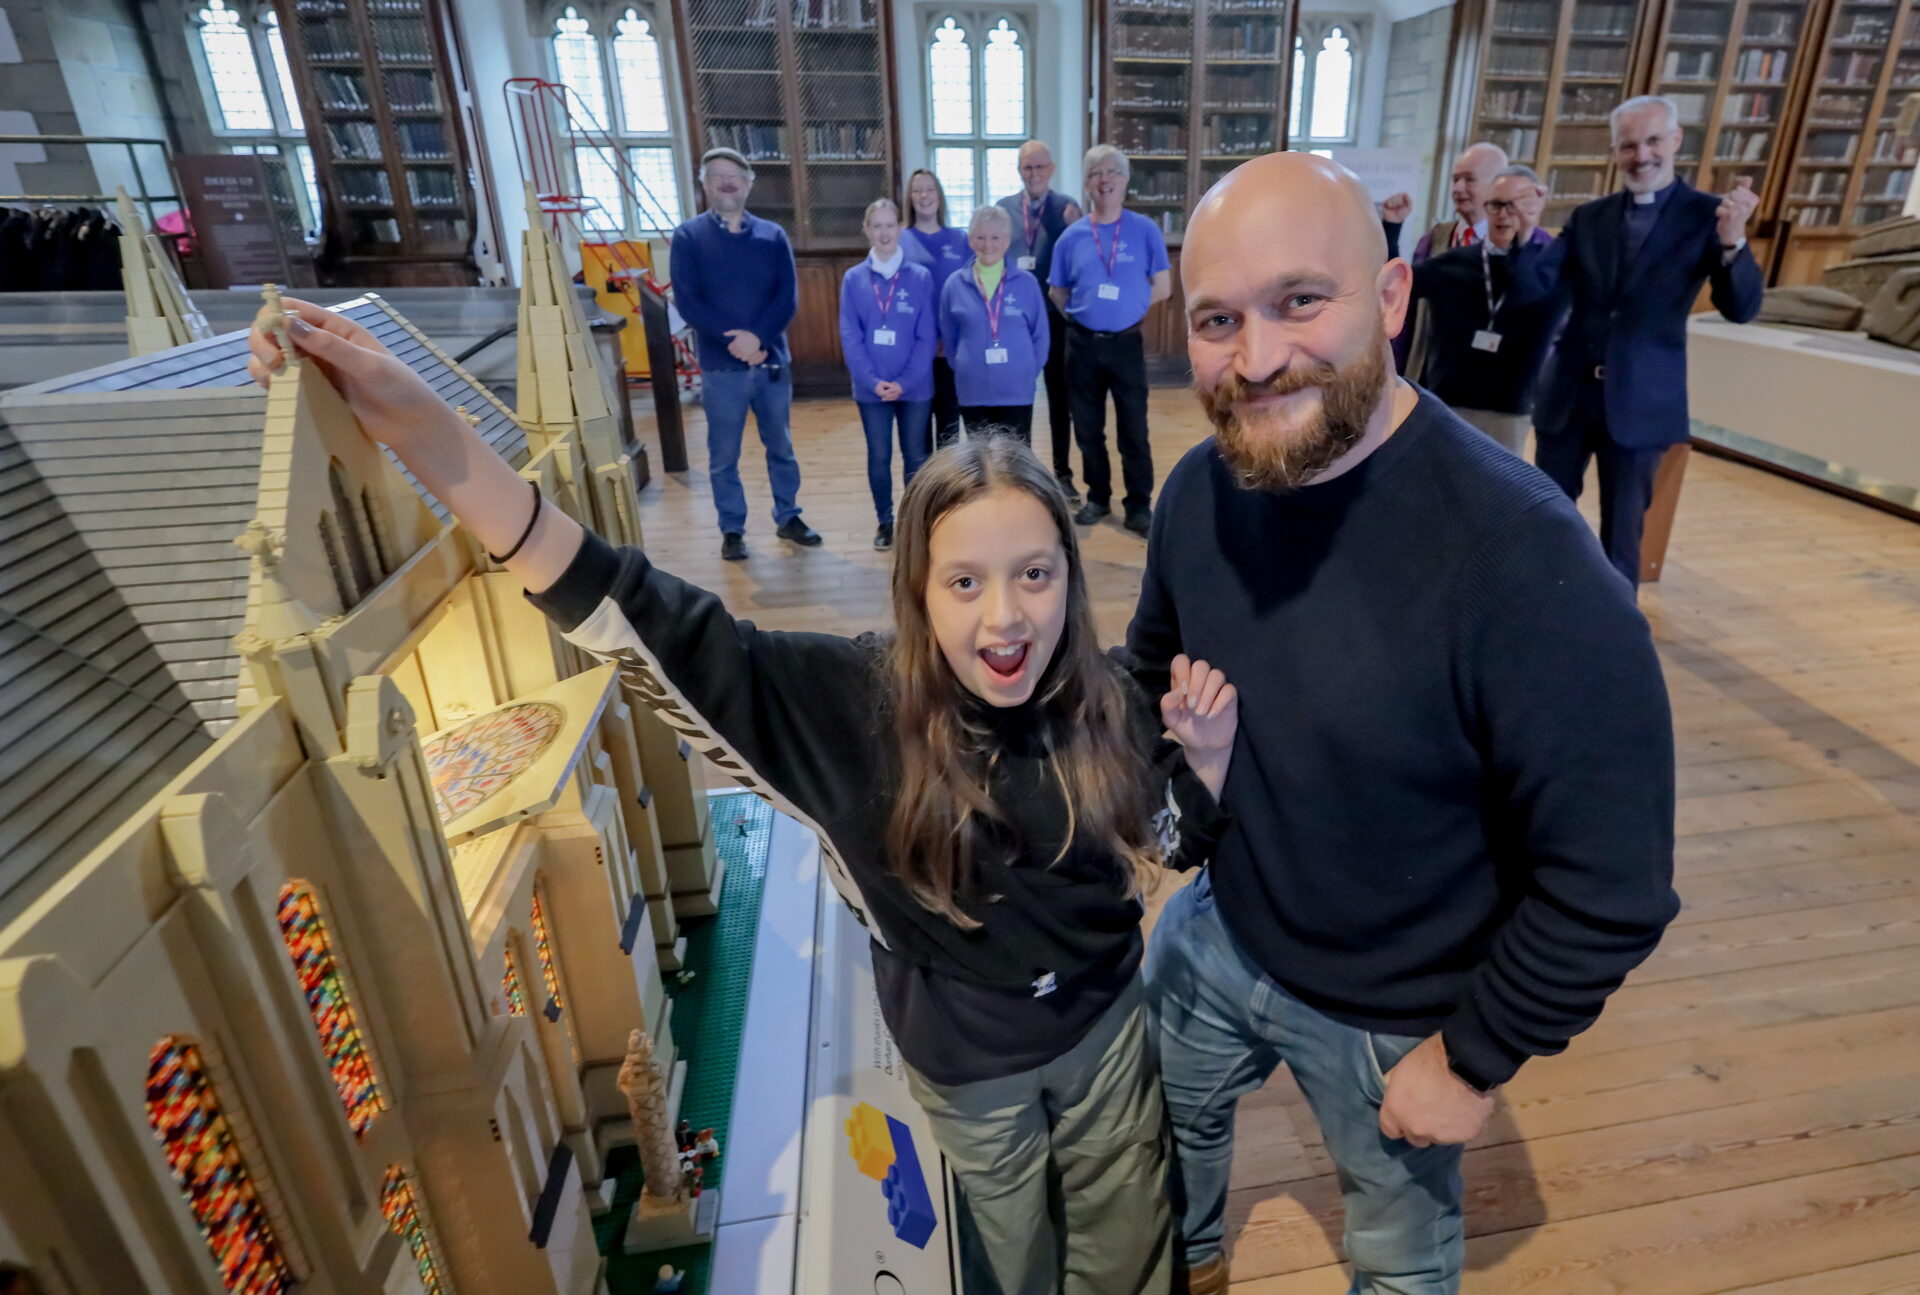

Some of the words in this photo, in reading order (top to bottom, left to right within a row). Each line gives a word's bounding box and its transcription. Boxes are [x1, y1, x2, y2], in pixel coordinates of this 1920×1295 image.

[873, 1019, 881, 1046] thanks
[873, 1047, 881, 1069] With
[884, 1040, 893, 1076] Durham
